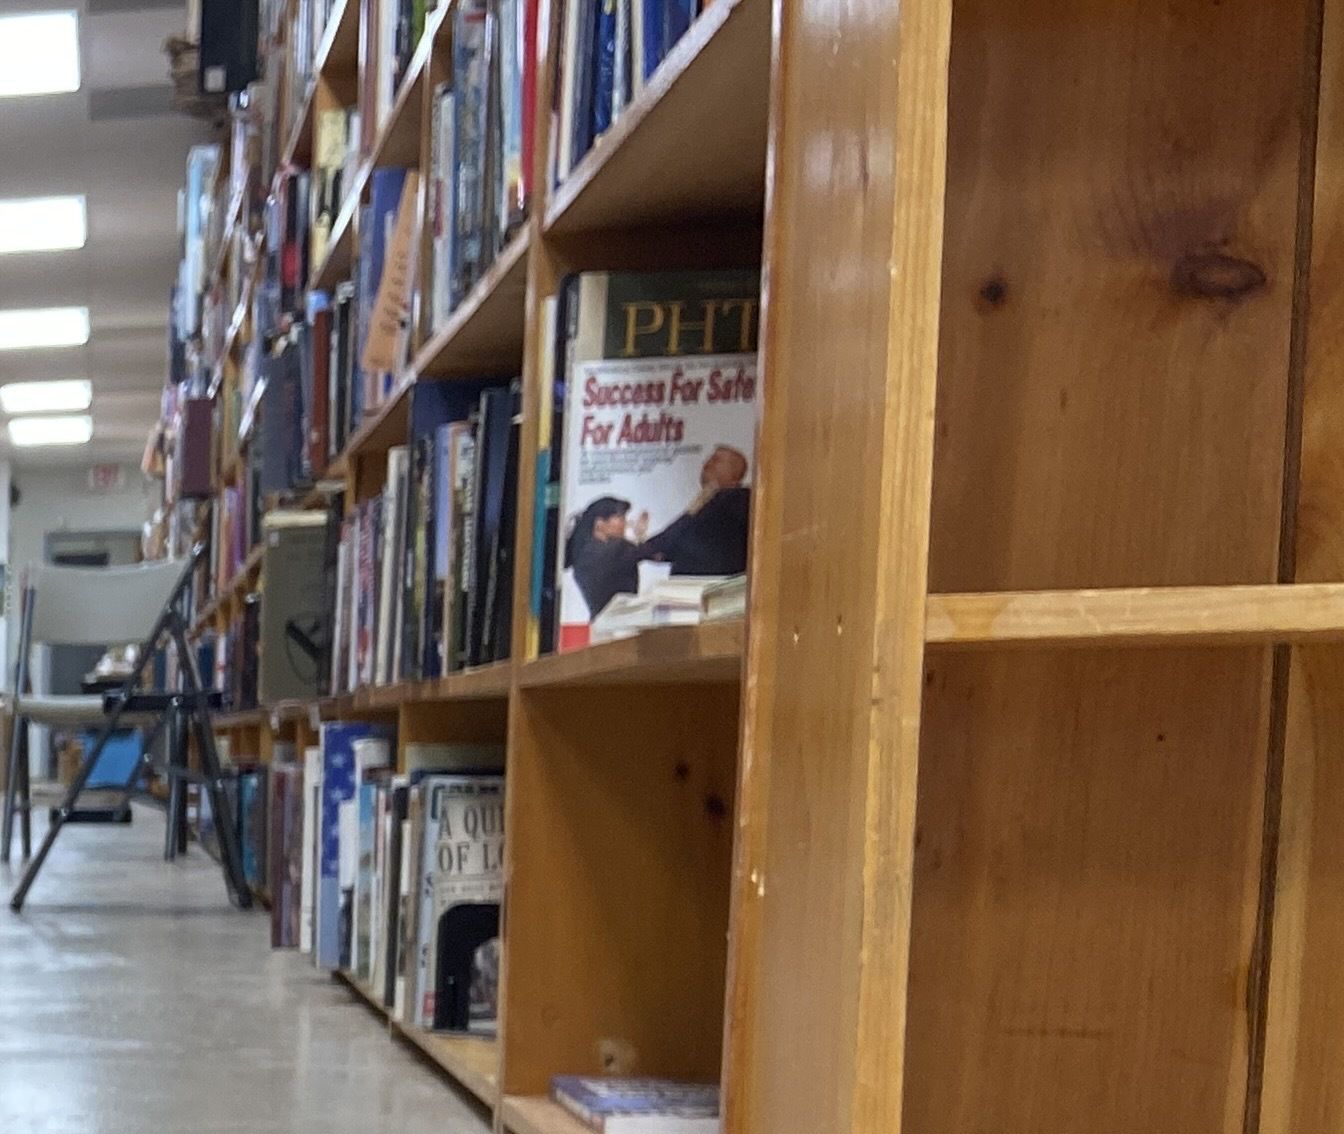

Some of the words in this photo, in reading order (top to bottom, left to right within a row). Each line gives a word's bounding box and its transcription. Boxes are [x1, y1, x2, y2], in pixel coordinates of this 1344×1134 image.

[583, 376, 665, 406] Success
[669, 367, 703, 404] For
[706, 366, 755, 404] Safe
[580, 415, 613, 446] For
[617, 412, 685, 445] Adults
